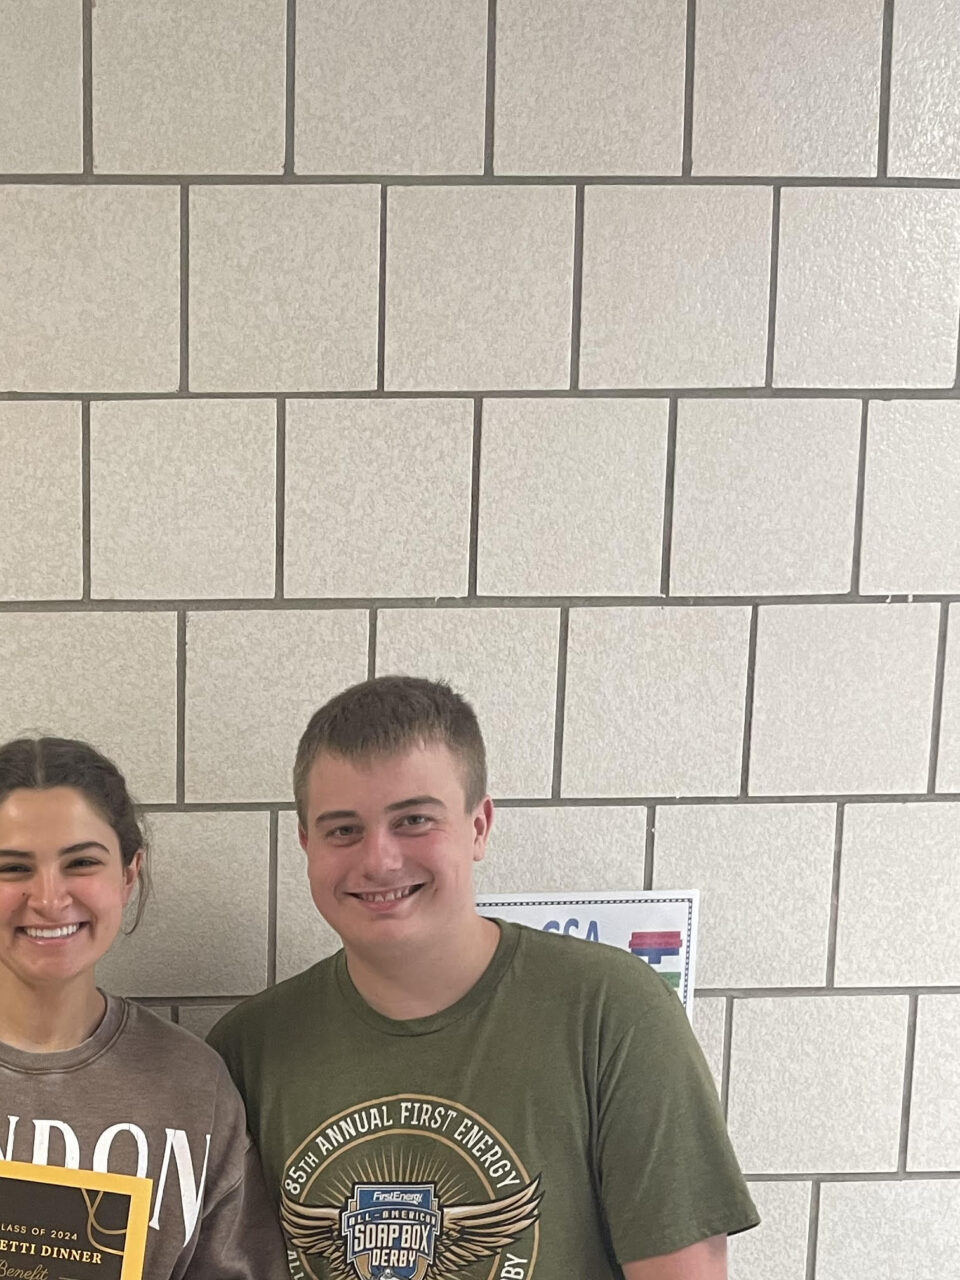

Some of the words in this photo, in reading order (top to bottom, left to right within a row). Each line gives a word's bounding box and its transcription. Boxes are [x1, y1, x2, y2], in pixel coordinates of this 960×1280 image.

[285, 1152, 318, 1194] 85TH
[315, 1105, 393, 1155] ANNUAL
[400, 1102, 456, 1131] FIRST
[453, 1118, 520, 1189] ENERGY
[373, 1192, 423, 1205] FirstEnergy
[349, 1210, 437, 1225] ALL-AMERICAN
[32, 1227, 46, 1236] OF
[51, 1230, 78, 1241] 2024
[354, 1224, 399, 1251] SOAP
[401, 1225, 431, 1253] BOX
[41, 1245, 102, 1264] DINNER
[372, 1250, 416, 1267] DERBY
